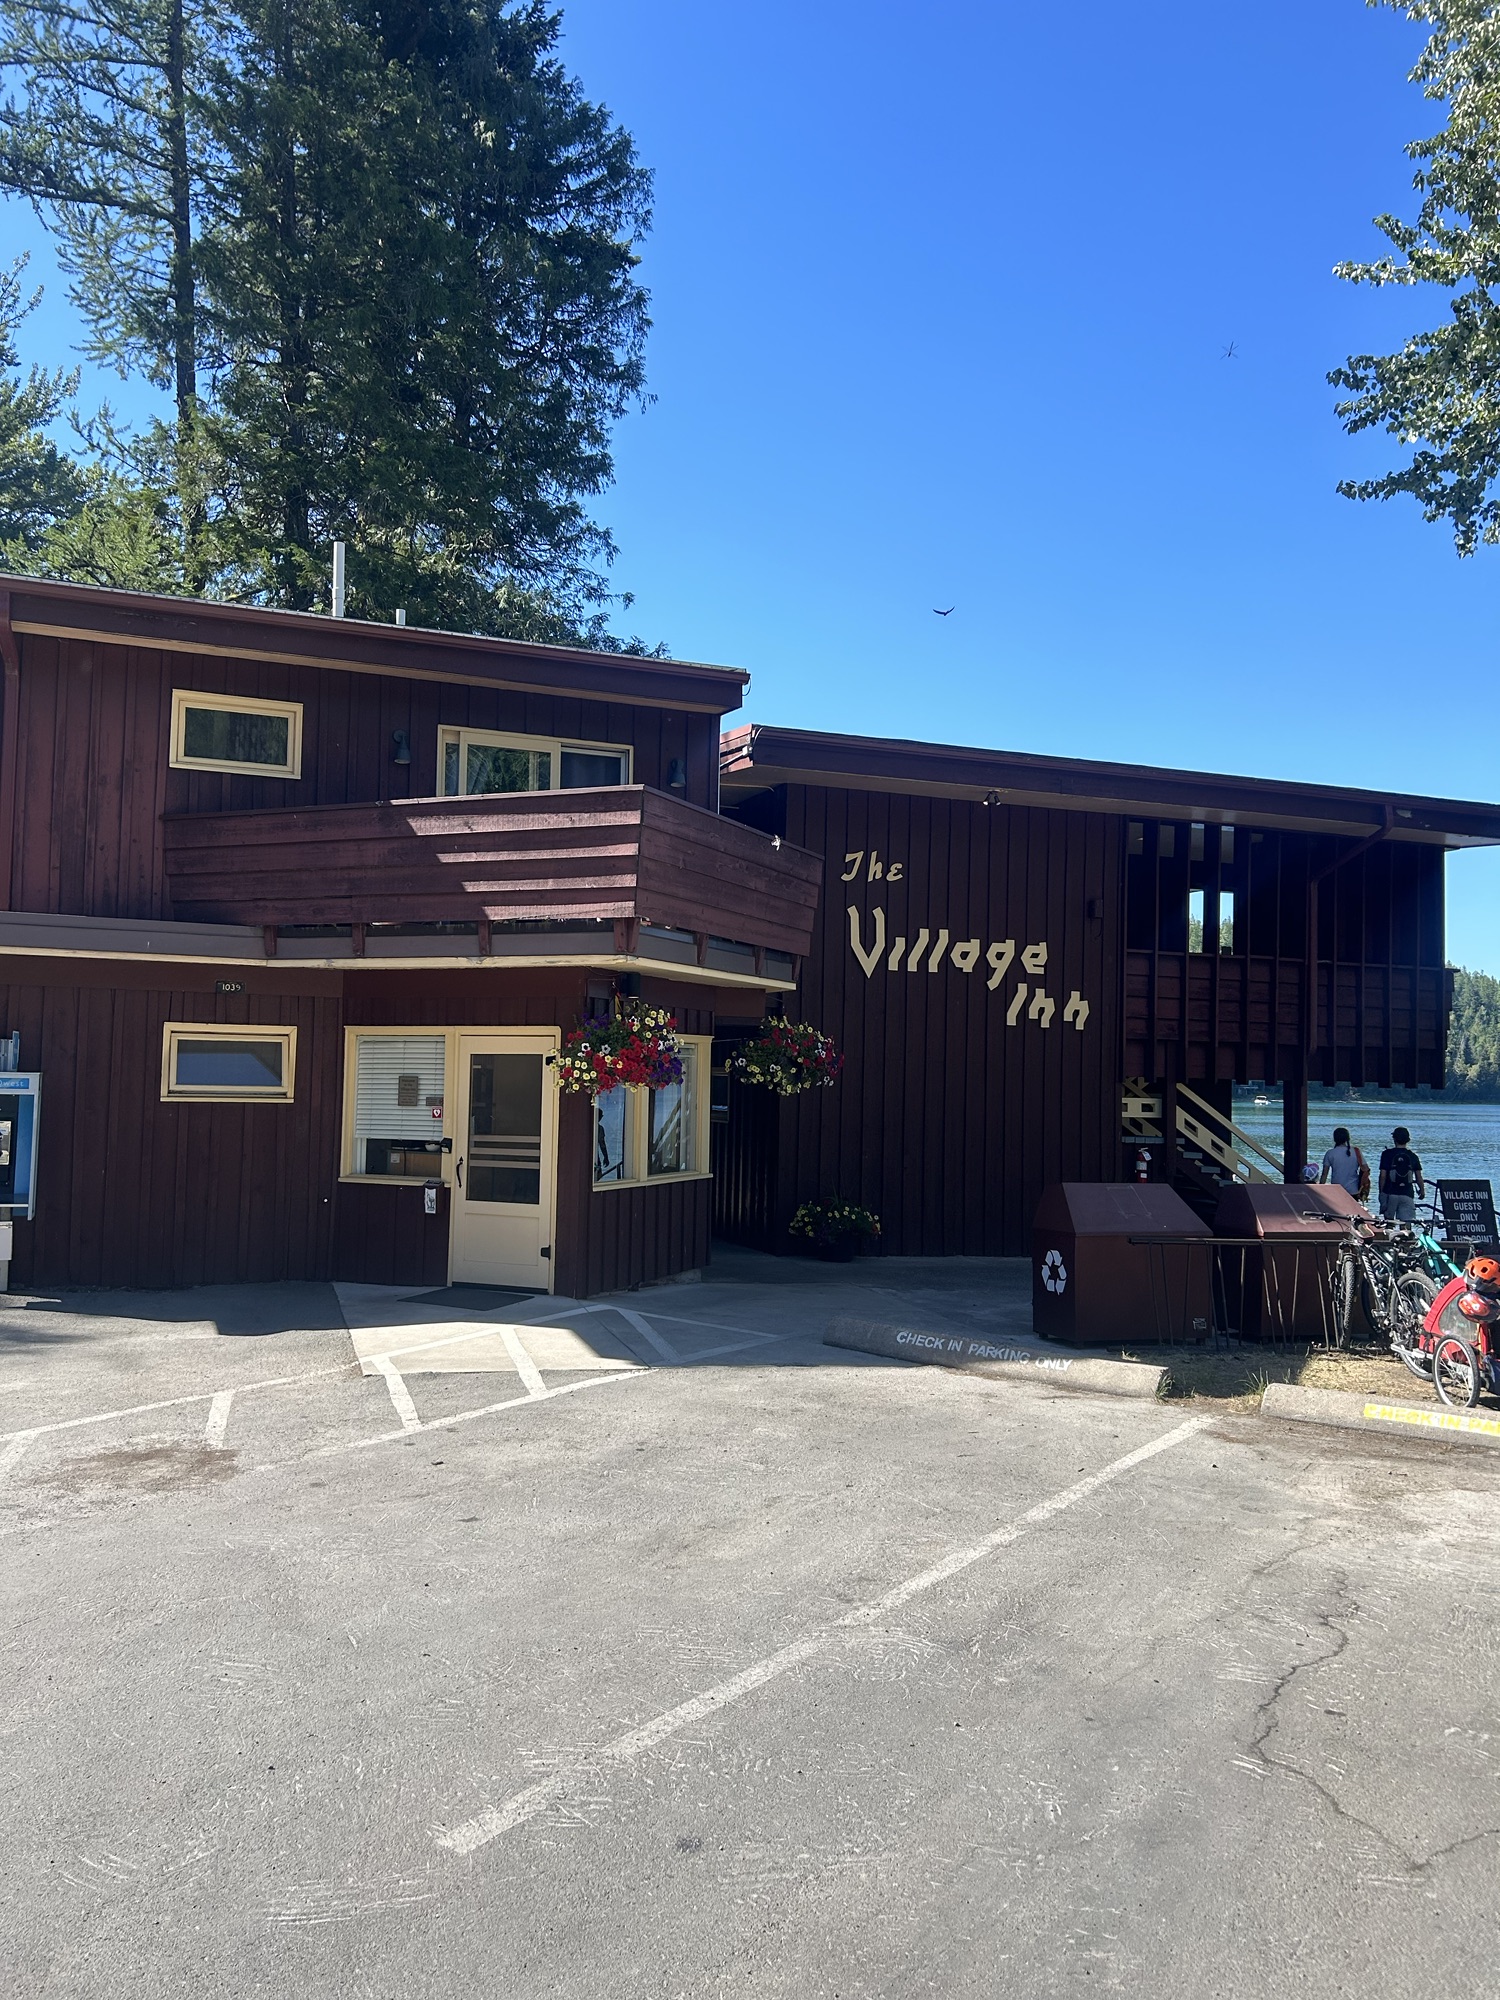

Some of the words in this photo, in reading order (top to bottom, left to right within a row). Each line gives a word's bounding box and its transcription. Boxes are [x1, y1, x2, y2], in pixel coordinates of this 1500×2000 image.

[841, 851, 903, 882] The
[847, 905, 1048, 991] Village
[222, 983, 241, 991] 1039
[1006, 983, 1089, 1030] Inn
[1443, 1191, 1474, 1199] VILLAGE
[1475, 1191, 1489, 1199] INN
[1453, 1202, 1482, 1210] GUESTS
[1460, 1213, 1478, 1221] ONLY
[1456, 1224, 1486, 1232] BEYOND
[896, 1331, 945, 1350] CHECK
[947, 1339, 963, 1352] IN
[967, 1343, 1031, 1364] PARKING
[1034, 1356, 1073, 1371] ONLY
[1364, 1404, 1433, 1425] CHECK
[1439, 1414, 1462, 1429] IN
